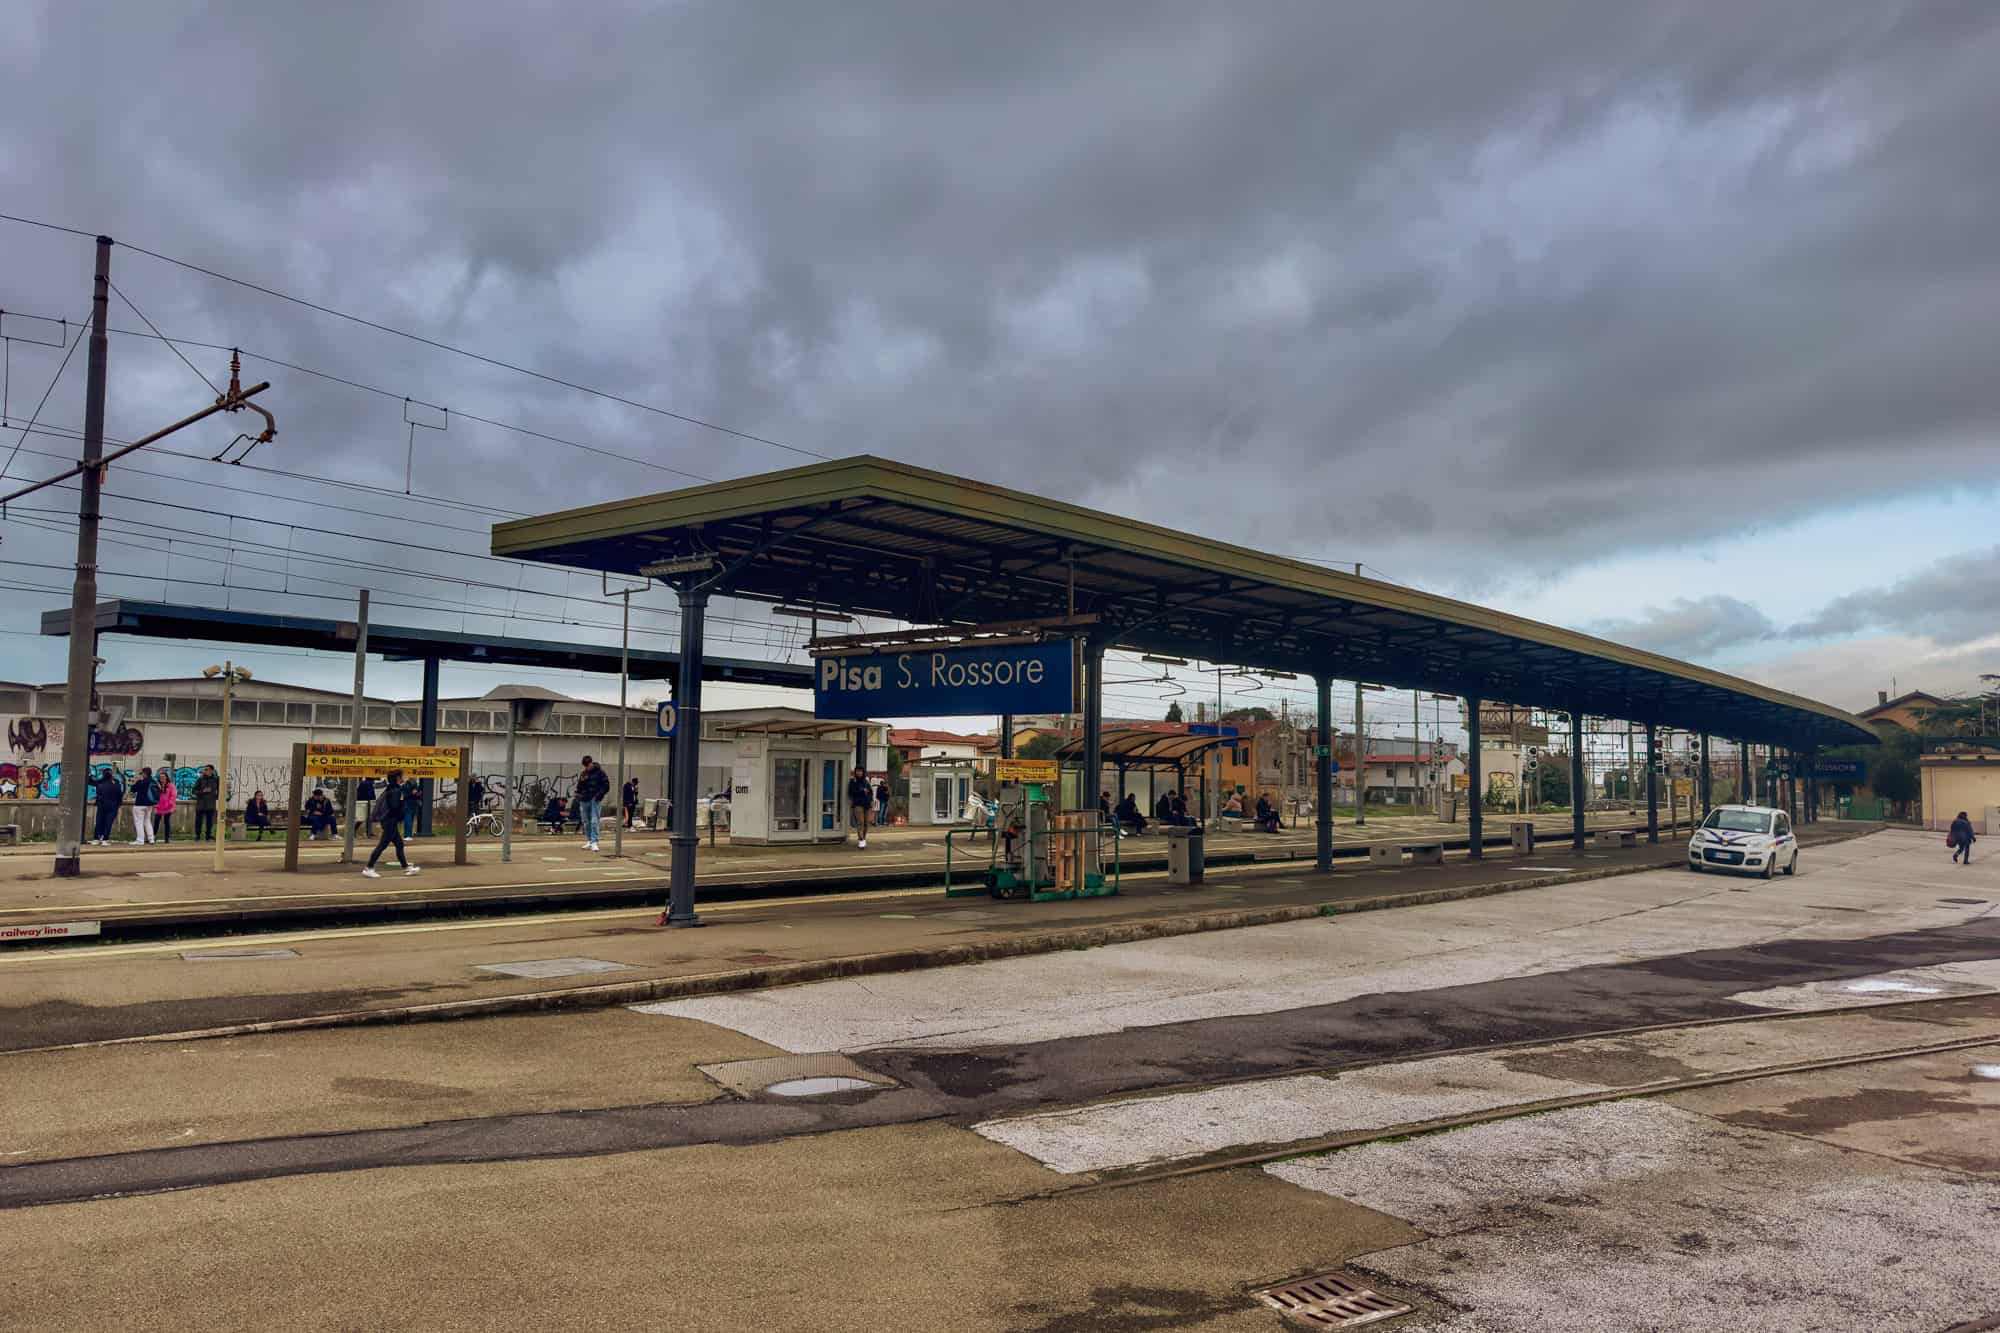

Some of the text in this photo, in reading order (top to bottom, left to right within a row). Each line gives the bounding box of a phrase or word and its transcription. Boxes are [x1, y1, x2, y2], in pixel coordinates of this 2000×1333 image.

[821, 652, 1044, 691] Pisa S. Rossore
[0, 925, 69, 937] railway lines
